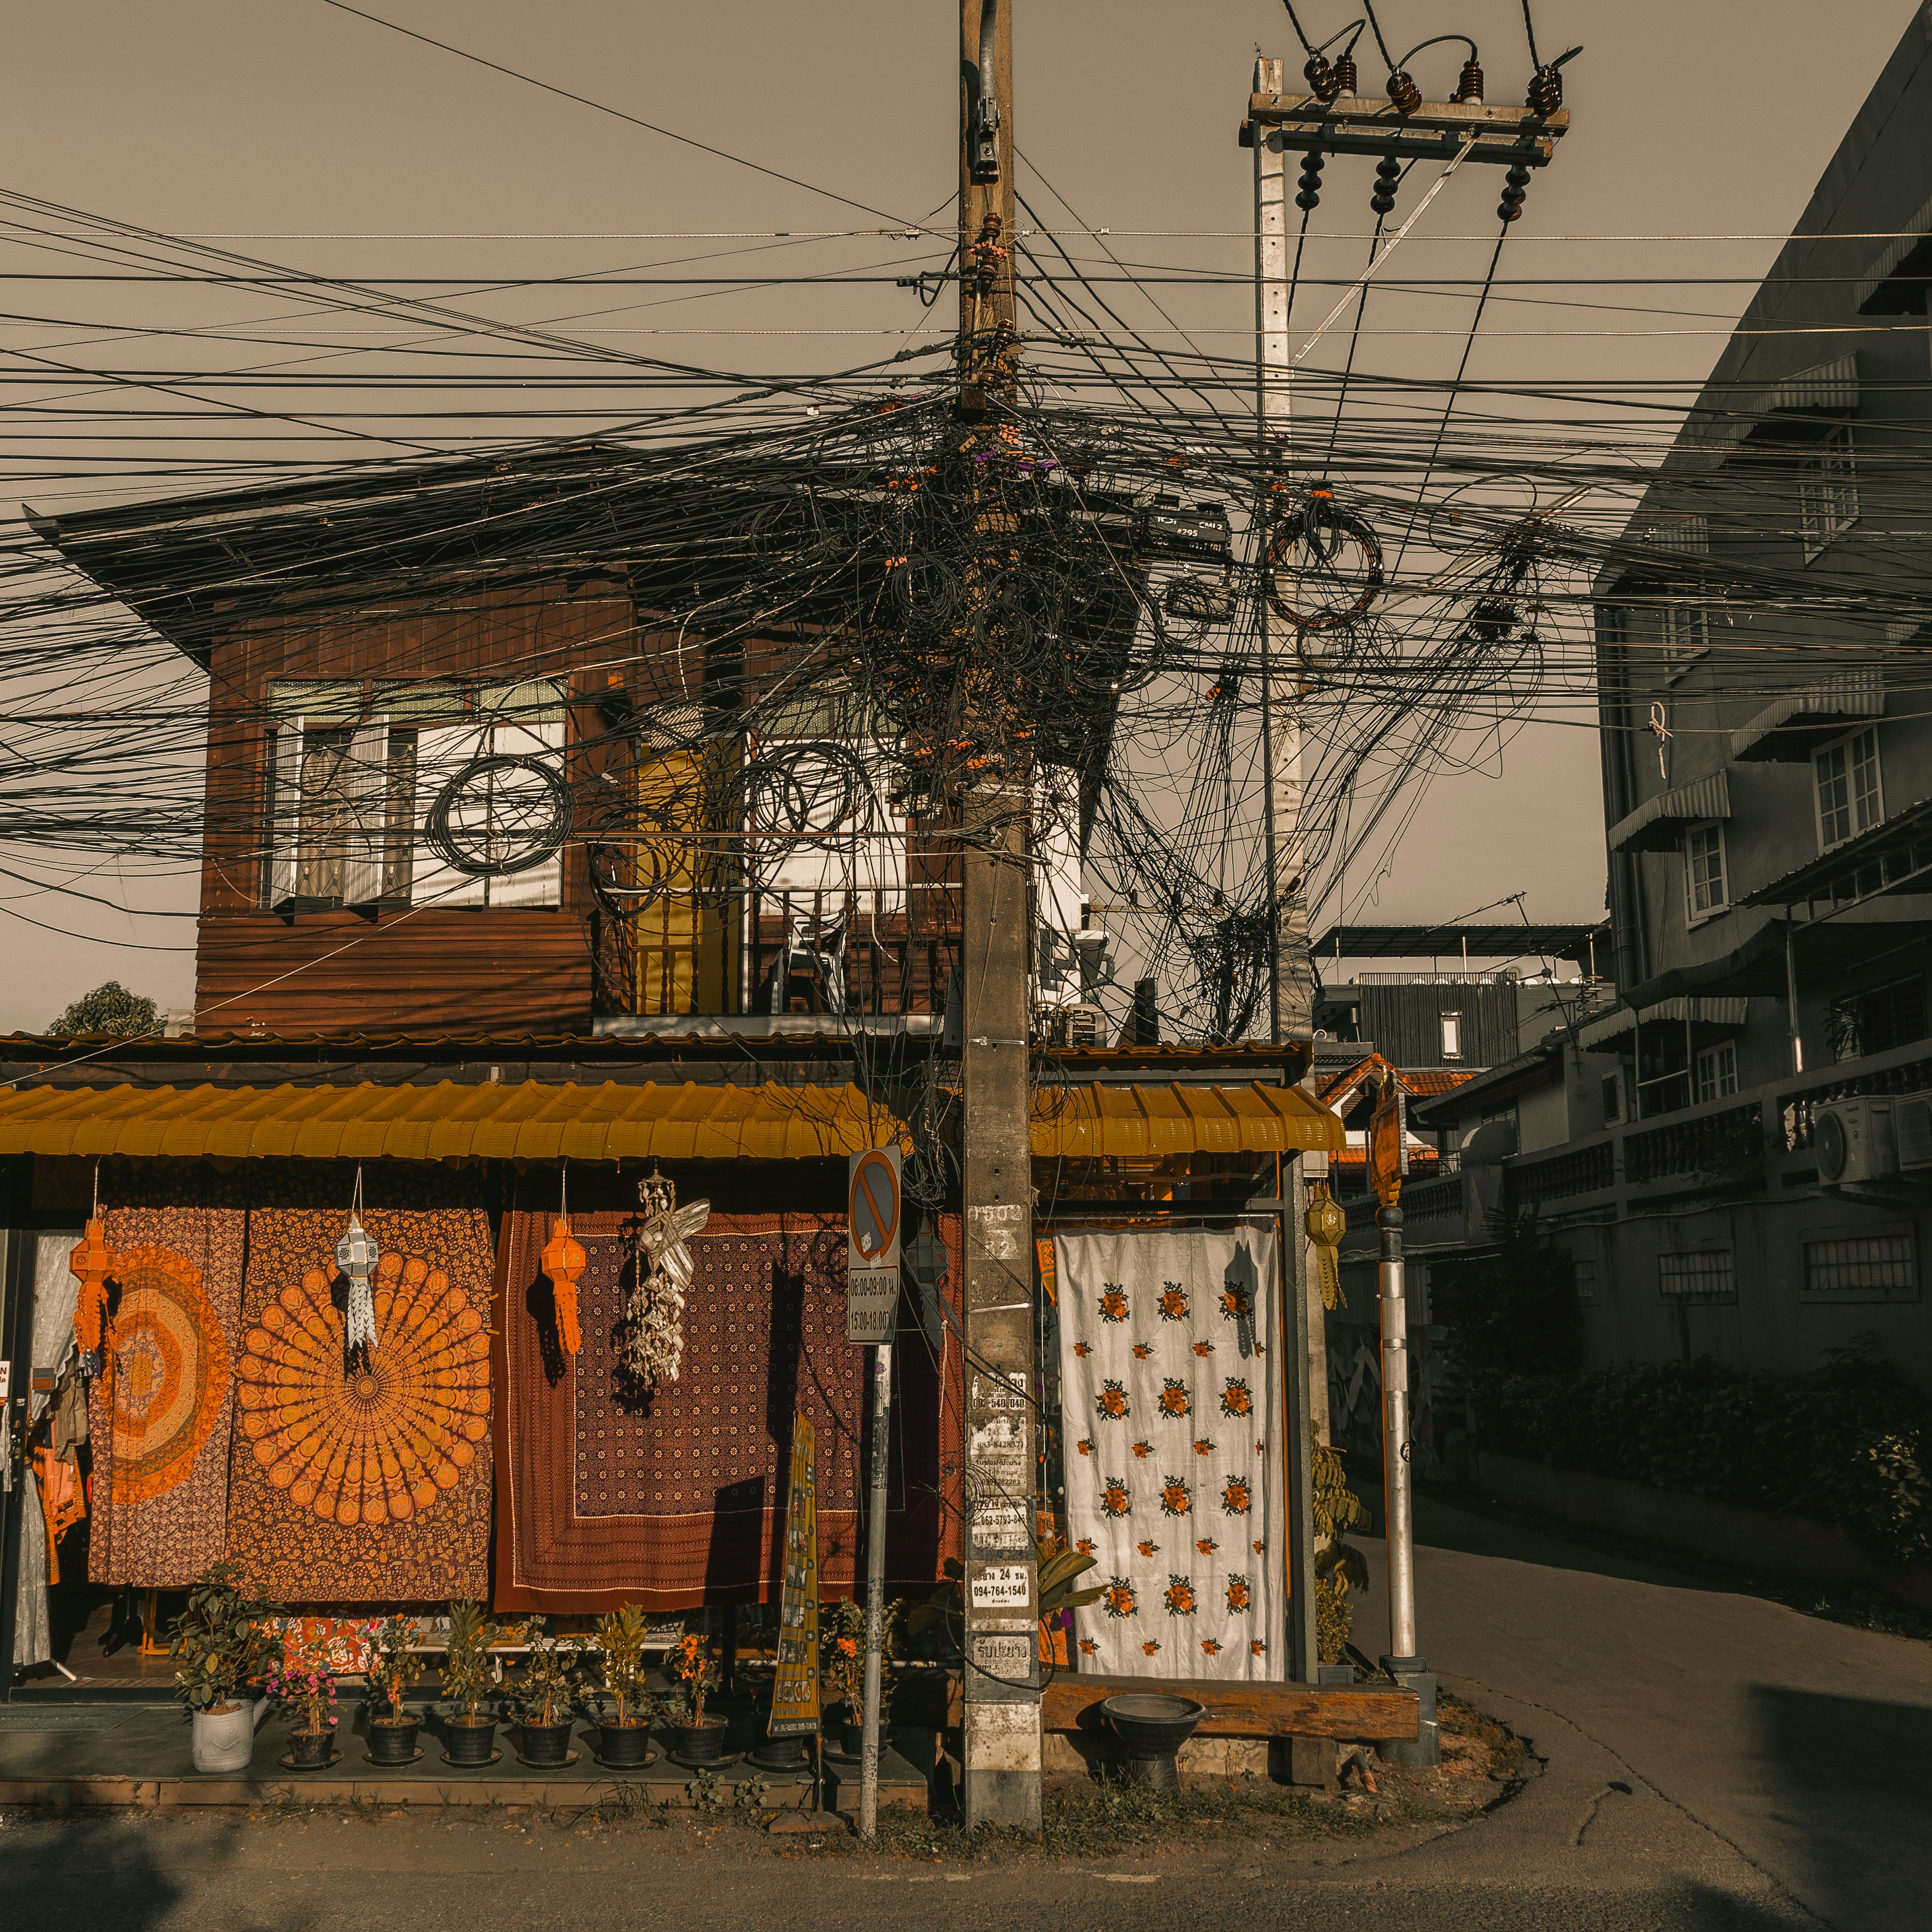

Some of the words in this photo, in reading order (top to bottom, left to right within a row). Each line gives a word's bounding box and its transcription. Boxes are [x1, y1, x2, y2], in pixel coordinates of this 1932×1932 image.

[1177, 528, 1198, 537] #295
[851, 1276, 887, 1297] 06:00-09:00
[851, 1311, 887, 1330] 15:00-18:00
[973, 1398, 1024, 1408] 092-540040
[1000, 1568, 1010, 1580] 24
[974, 1585, 1026, 1596] 094-764-1540
